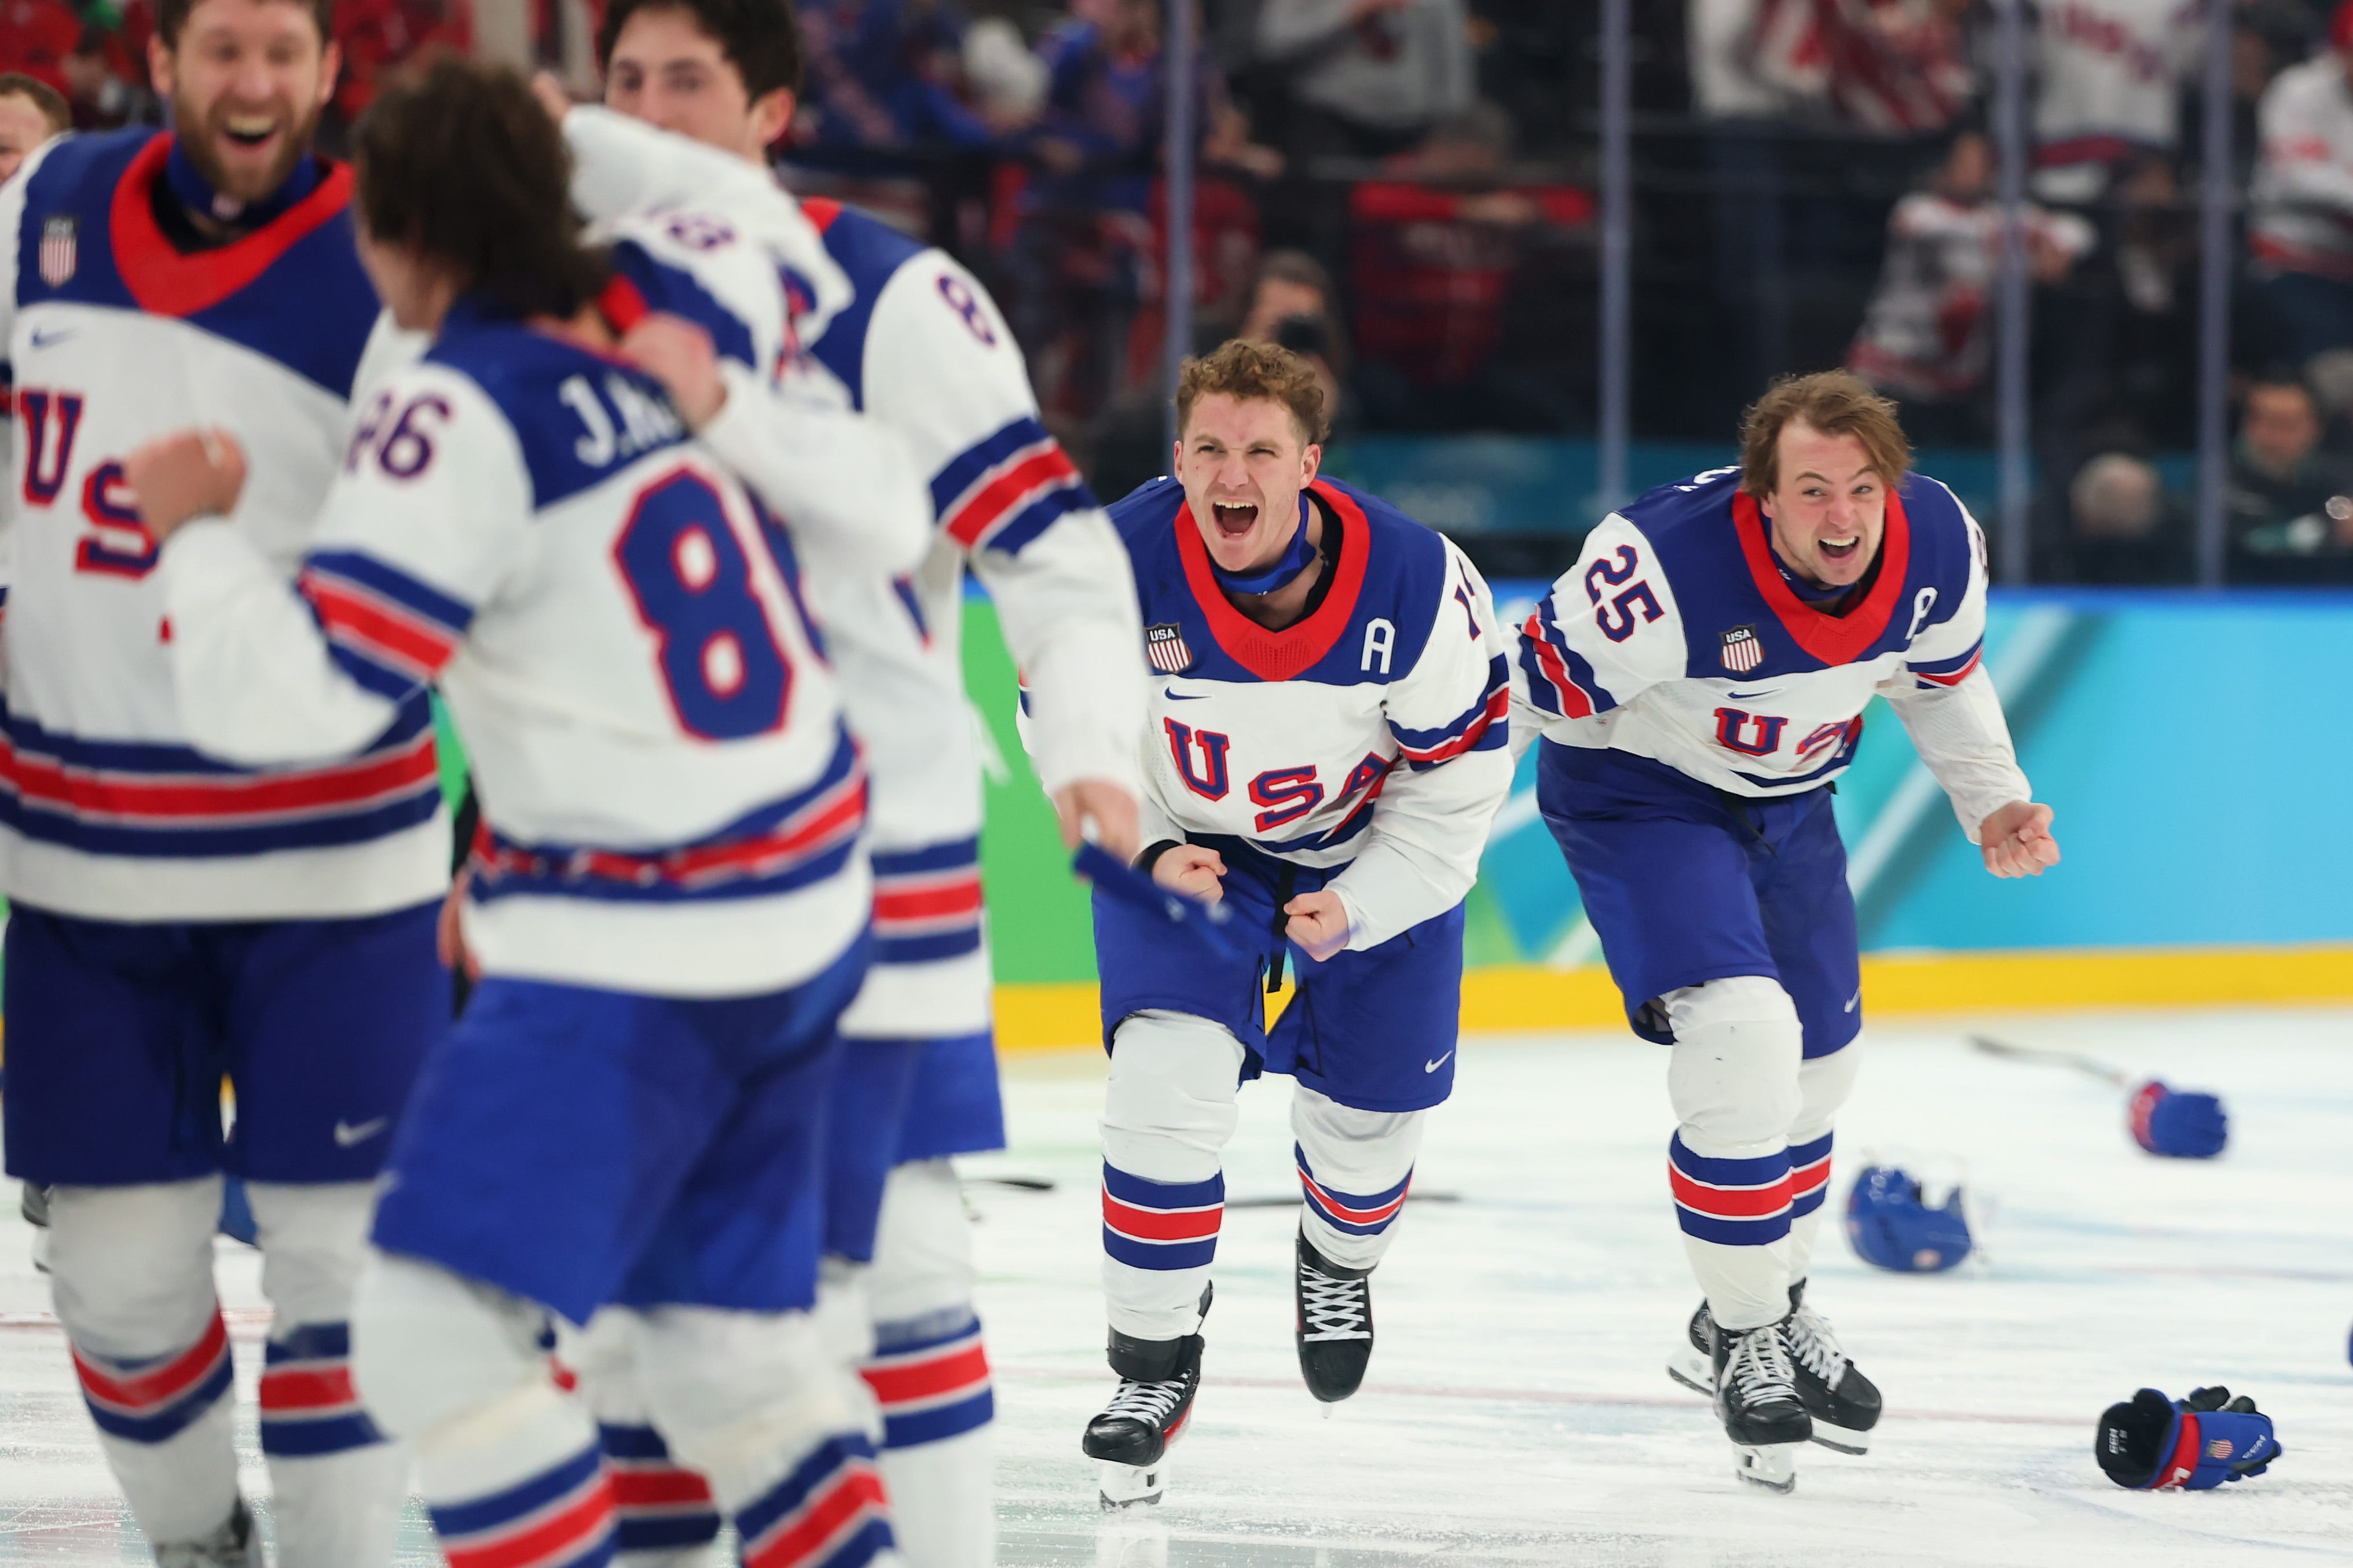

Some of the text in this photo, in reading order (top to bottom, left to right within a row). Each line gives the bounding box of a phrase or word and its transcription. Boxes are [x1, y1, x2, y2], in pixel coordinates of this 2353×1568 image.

[611, 462, 829, 744] 8
[1585, 544, 1666, 644] 25
[1149, 627, 1176, 642] USA
[1360, 617, 1397, 674] A
[1725, 629, 1752, 643] USA
[1163, 716, 1391, 833] USA
